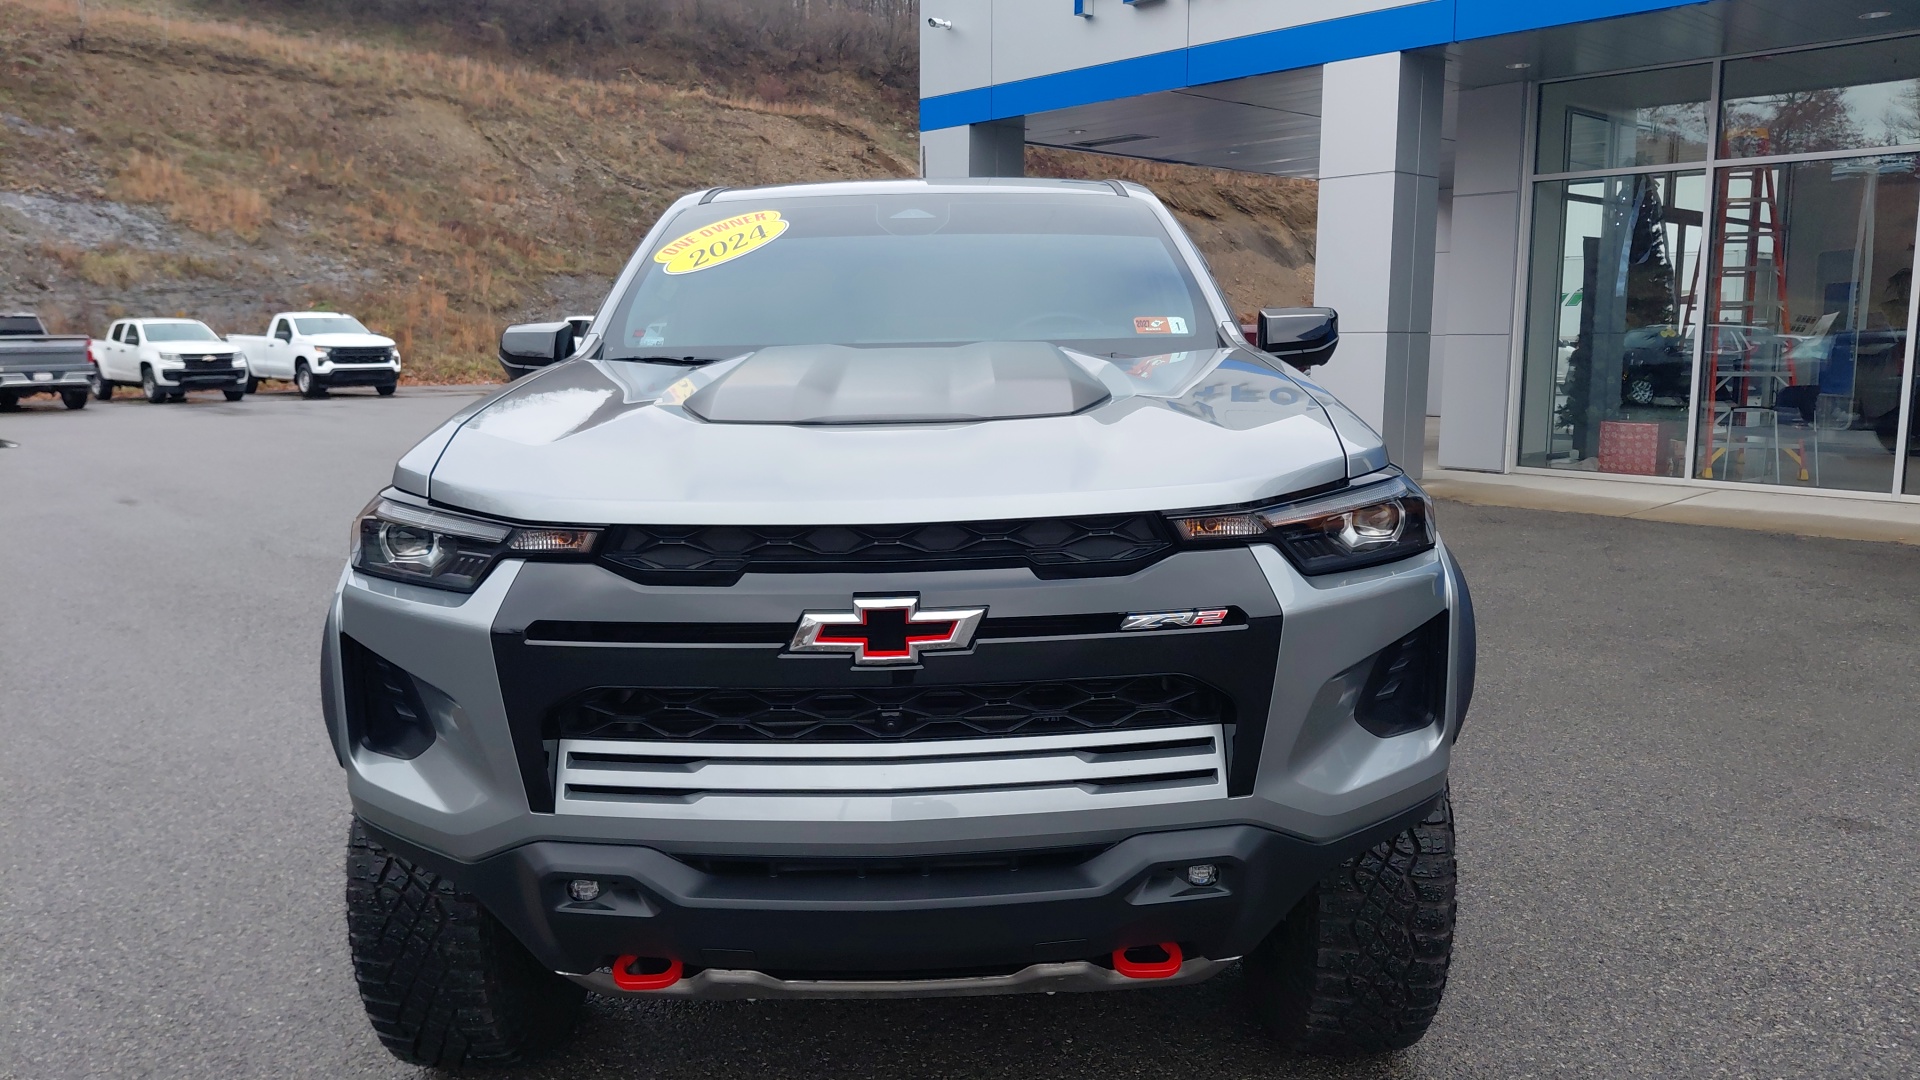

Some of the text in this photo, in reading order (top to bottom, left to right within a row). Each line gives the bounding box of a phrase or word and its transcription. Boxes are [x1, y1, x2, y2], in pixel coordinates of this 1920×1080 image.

[662, 212, 766, 255] ONE OWNER
[689, 224, 768, 268] 2024
[1120, 609, 1228, 630] ZR2
